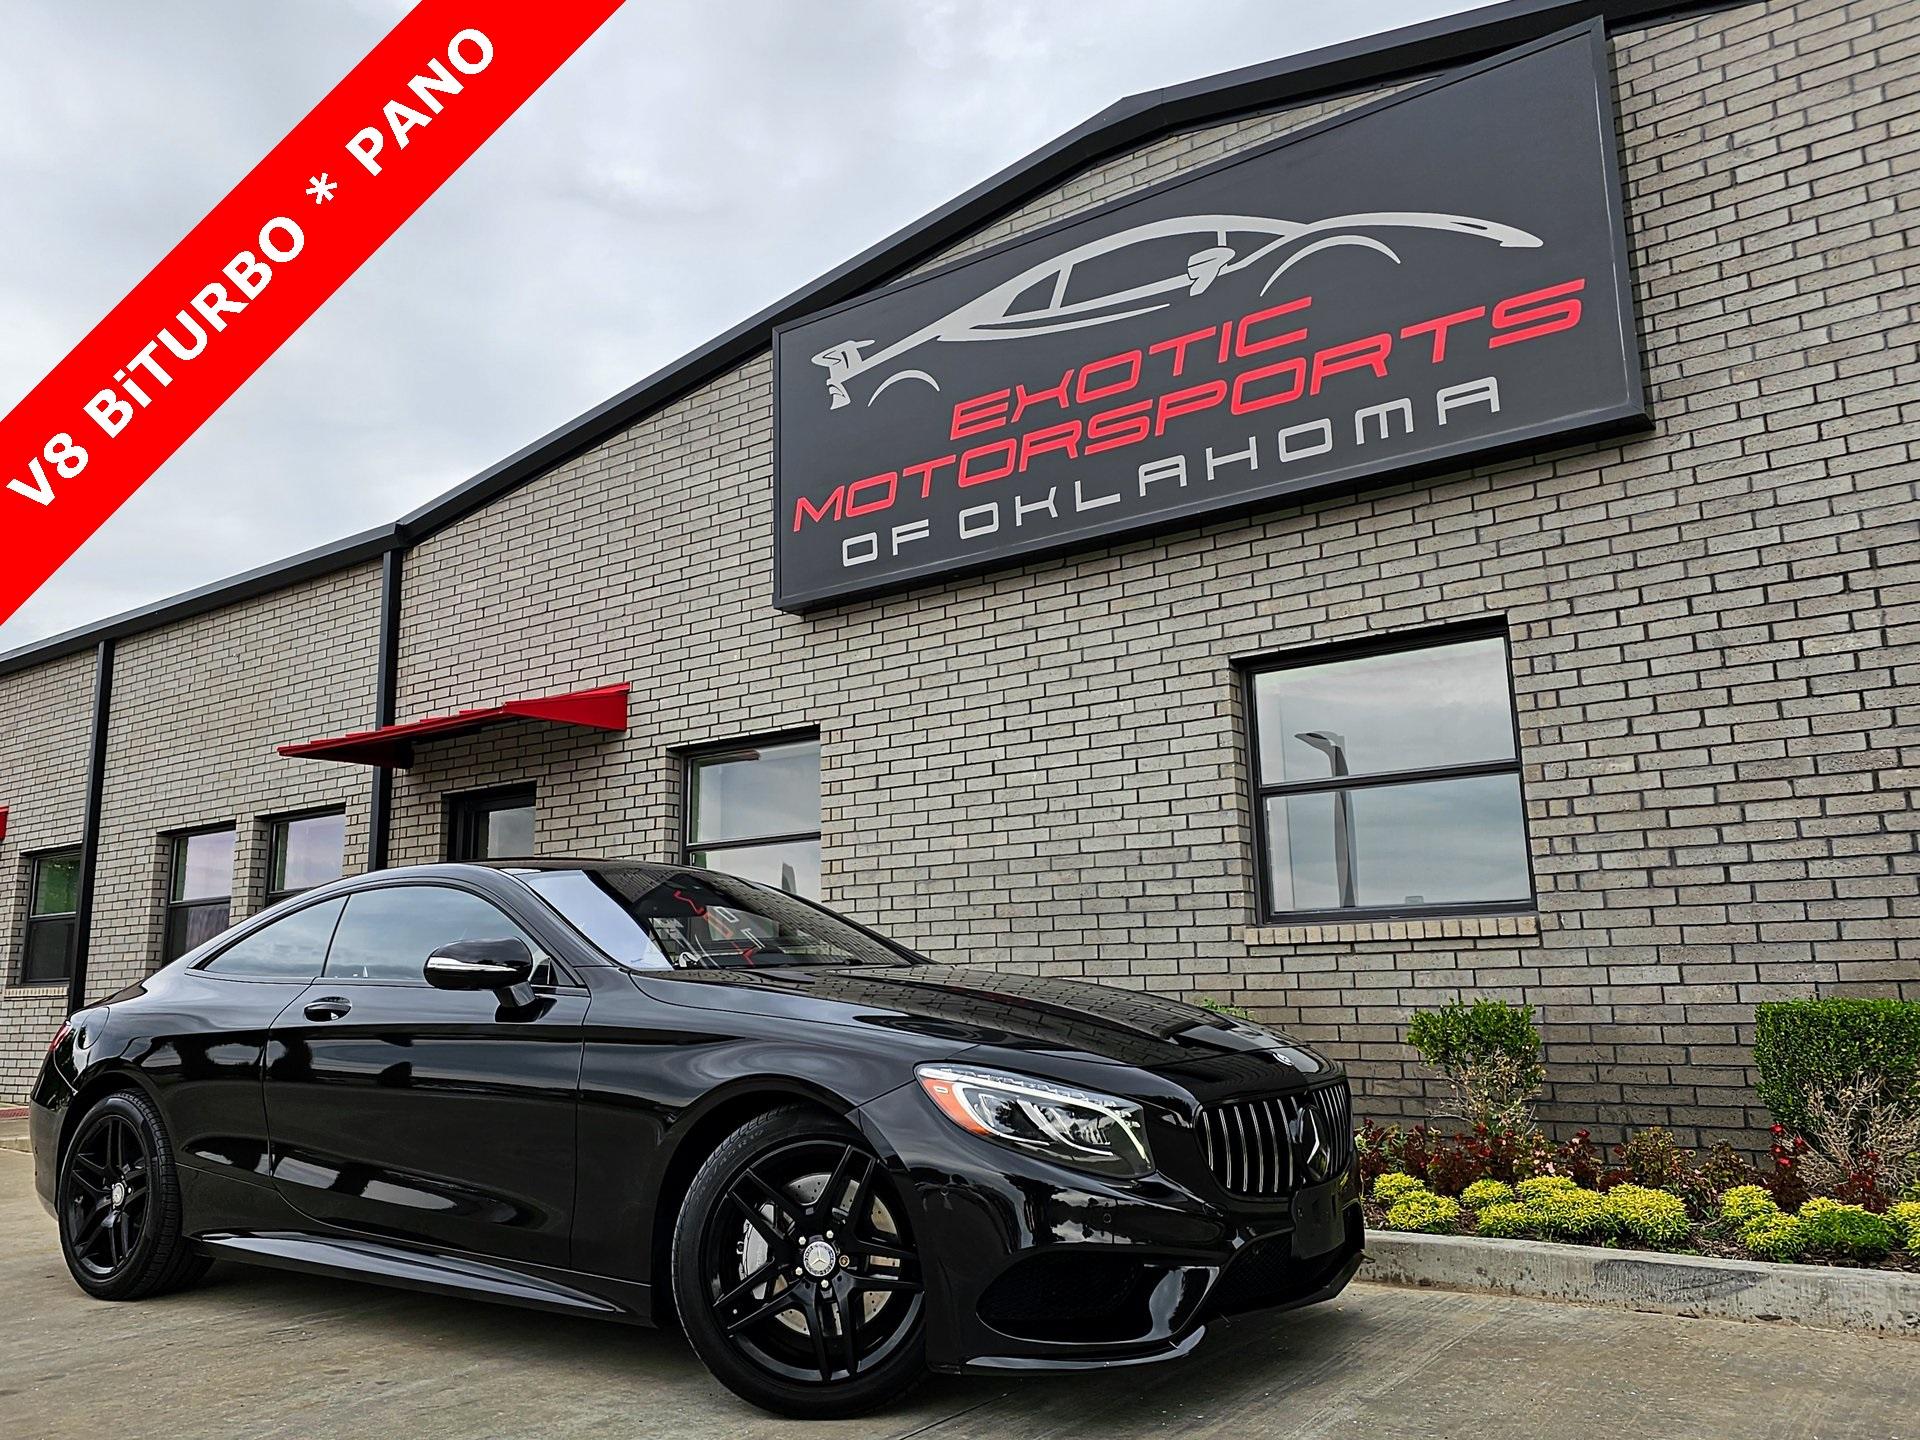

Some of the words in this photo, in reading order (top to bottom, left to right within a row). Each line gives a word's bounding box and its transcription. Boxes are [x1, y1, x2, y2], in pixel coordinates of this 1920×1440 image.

[793, 278, 1585, 532] MOTORSPORTS
[950, 296, 1312, 440] EXOTIC
[842, 518, 930, 568] OF
[958, 376, 1501, 540] OKLAHOMA
